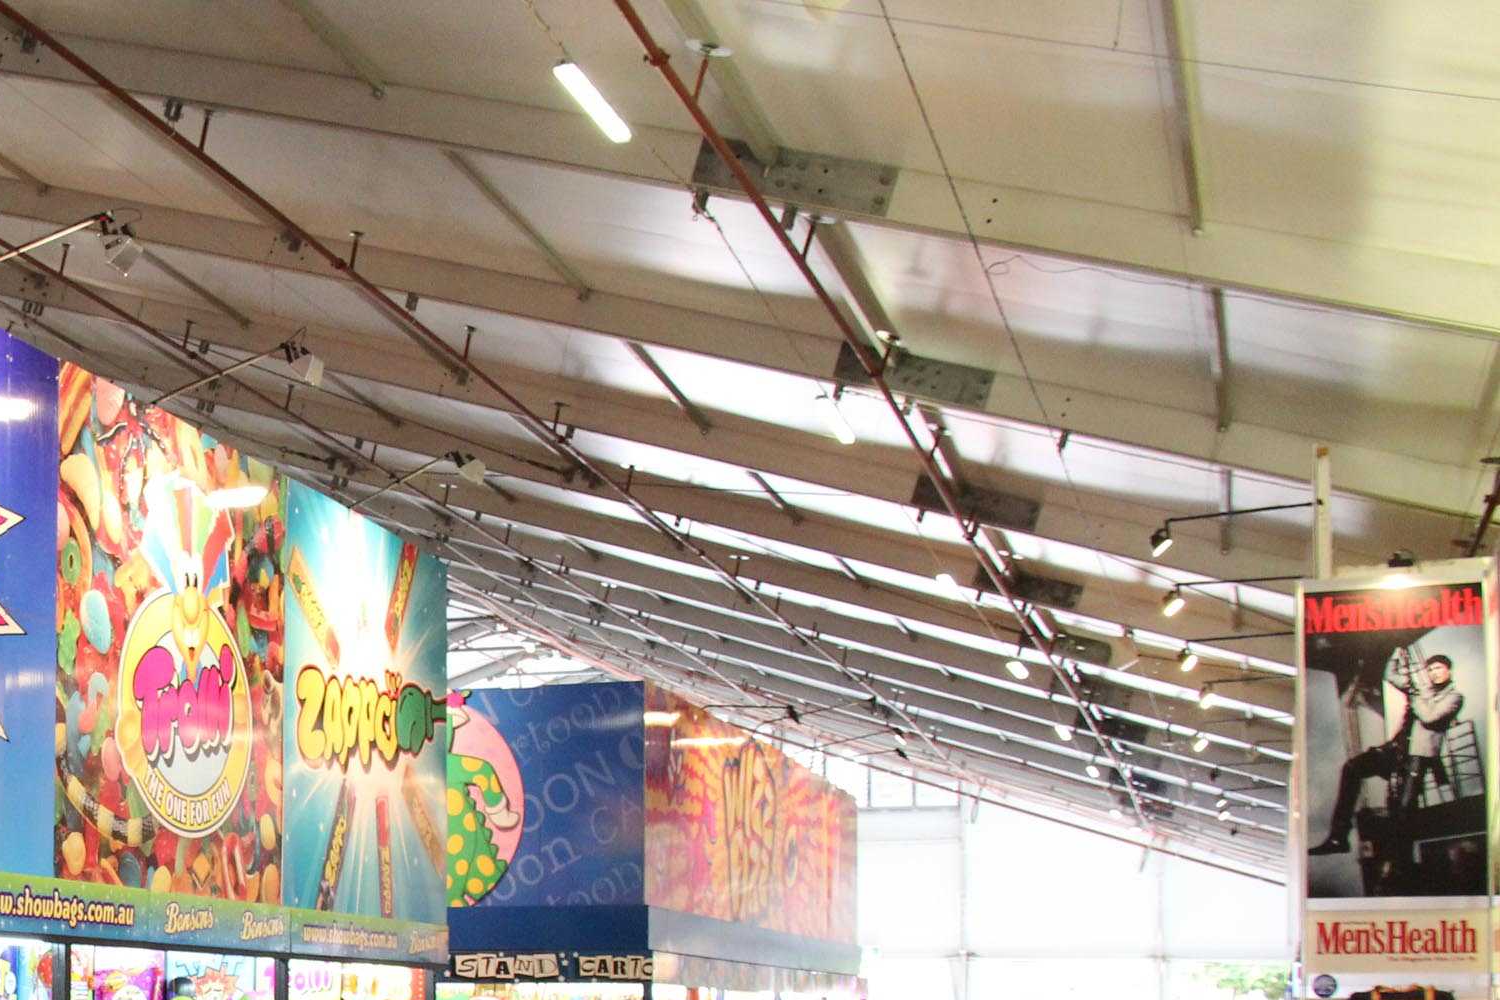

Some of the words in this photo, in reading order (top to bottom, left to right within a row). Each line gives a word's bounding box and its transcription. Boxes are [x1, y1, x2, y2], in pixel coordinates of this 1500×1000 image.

[166, 799, 188, 824] ONE
[189, 801, 211, 826] FOR
[164, 900, 215, 935] Bensons
[240, 910, 285, 942] Bensons
[458, 955, 559, 976] STAND
